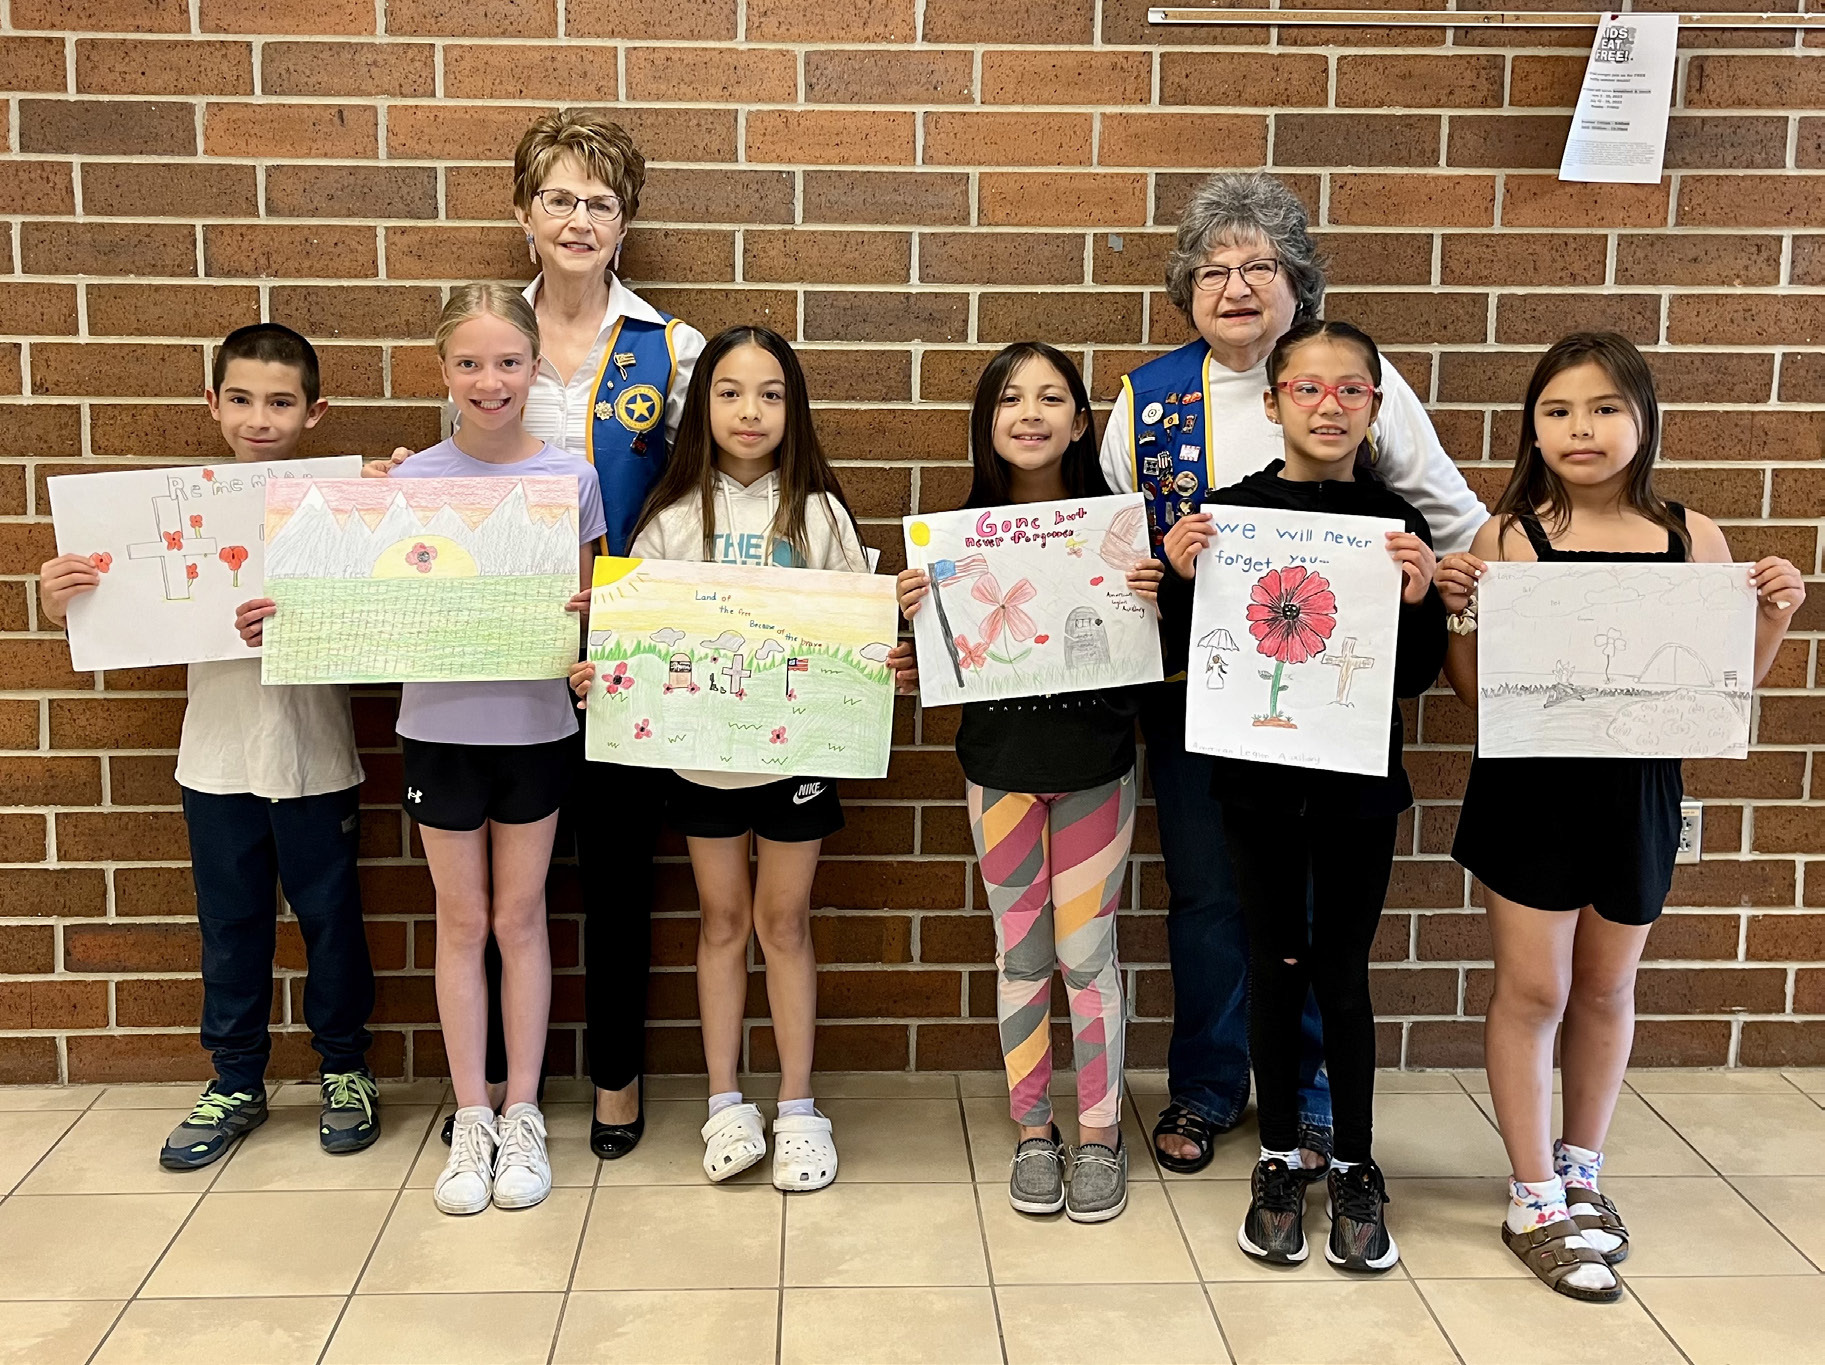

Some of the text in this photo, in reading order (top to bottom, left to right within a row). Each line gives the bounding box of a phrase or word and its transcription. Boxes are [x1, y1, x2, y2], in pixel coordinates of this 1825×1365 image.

[1601, 39, 1622, 50] EAT
[1595, 50, 1629, 62] FREE!
[1054, 508, 1087, 525] but
[712, 533, 764, 559] THE
[965, 536, 1004, 548] never
[1276, 528, 1313, 542] will
[1323, 530, 1372, 549] never
[1215, 550, 1272, 573] forget
[695, 590, 717, 601] Land
[719, 606, 751, 617] the free
[749, 620, 775, 630] Because
[785, 633, 798, 642] the
[800, 638, 823, 648] brave
[798, 781, 821, 796] NIKE
